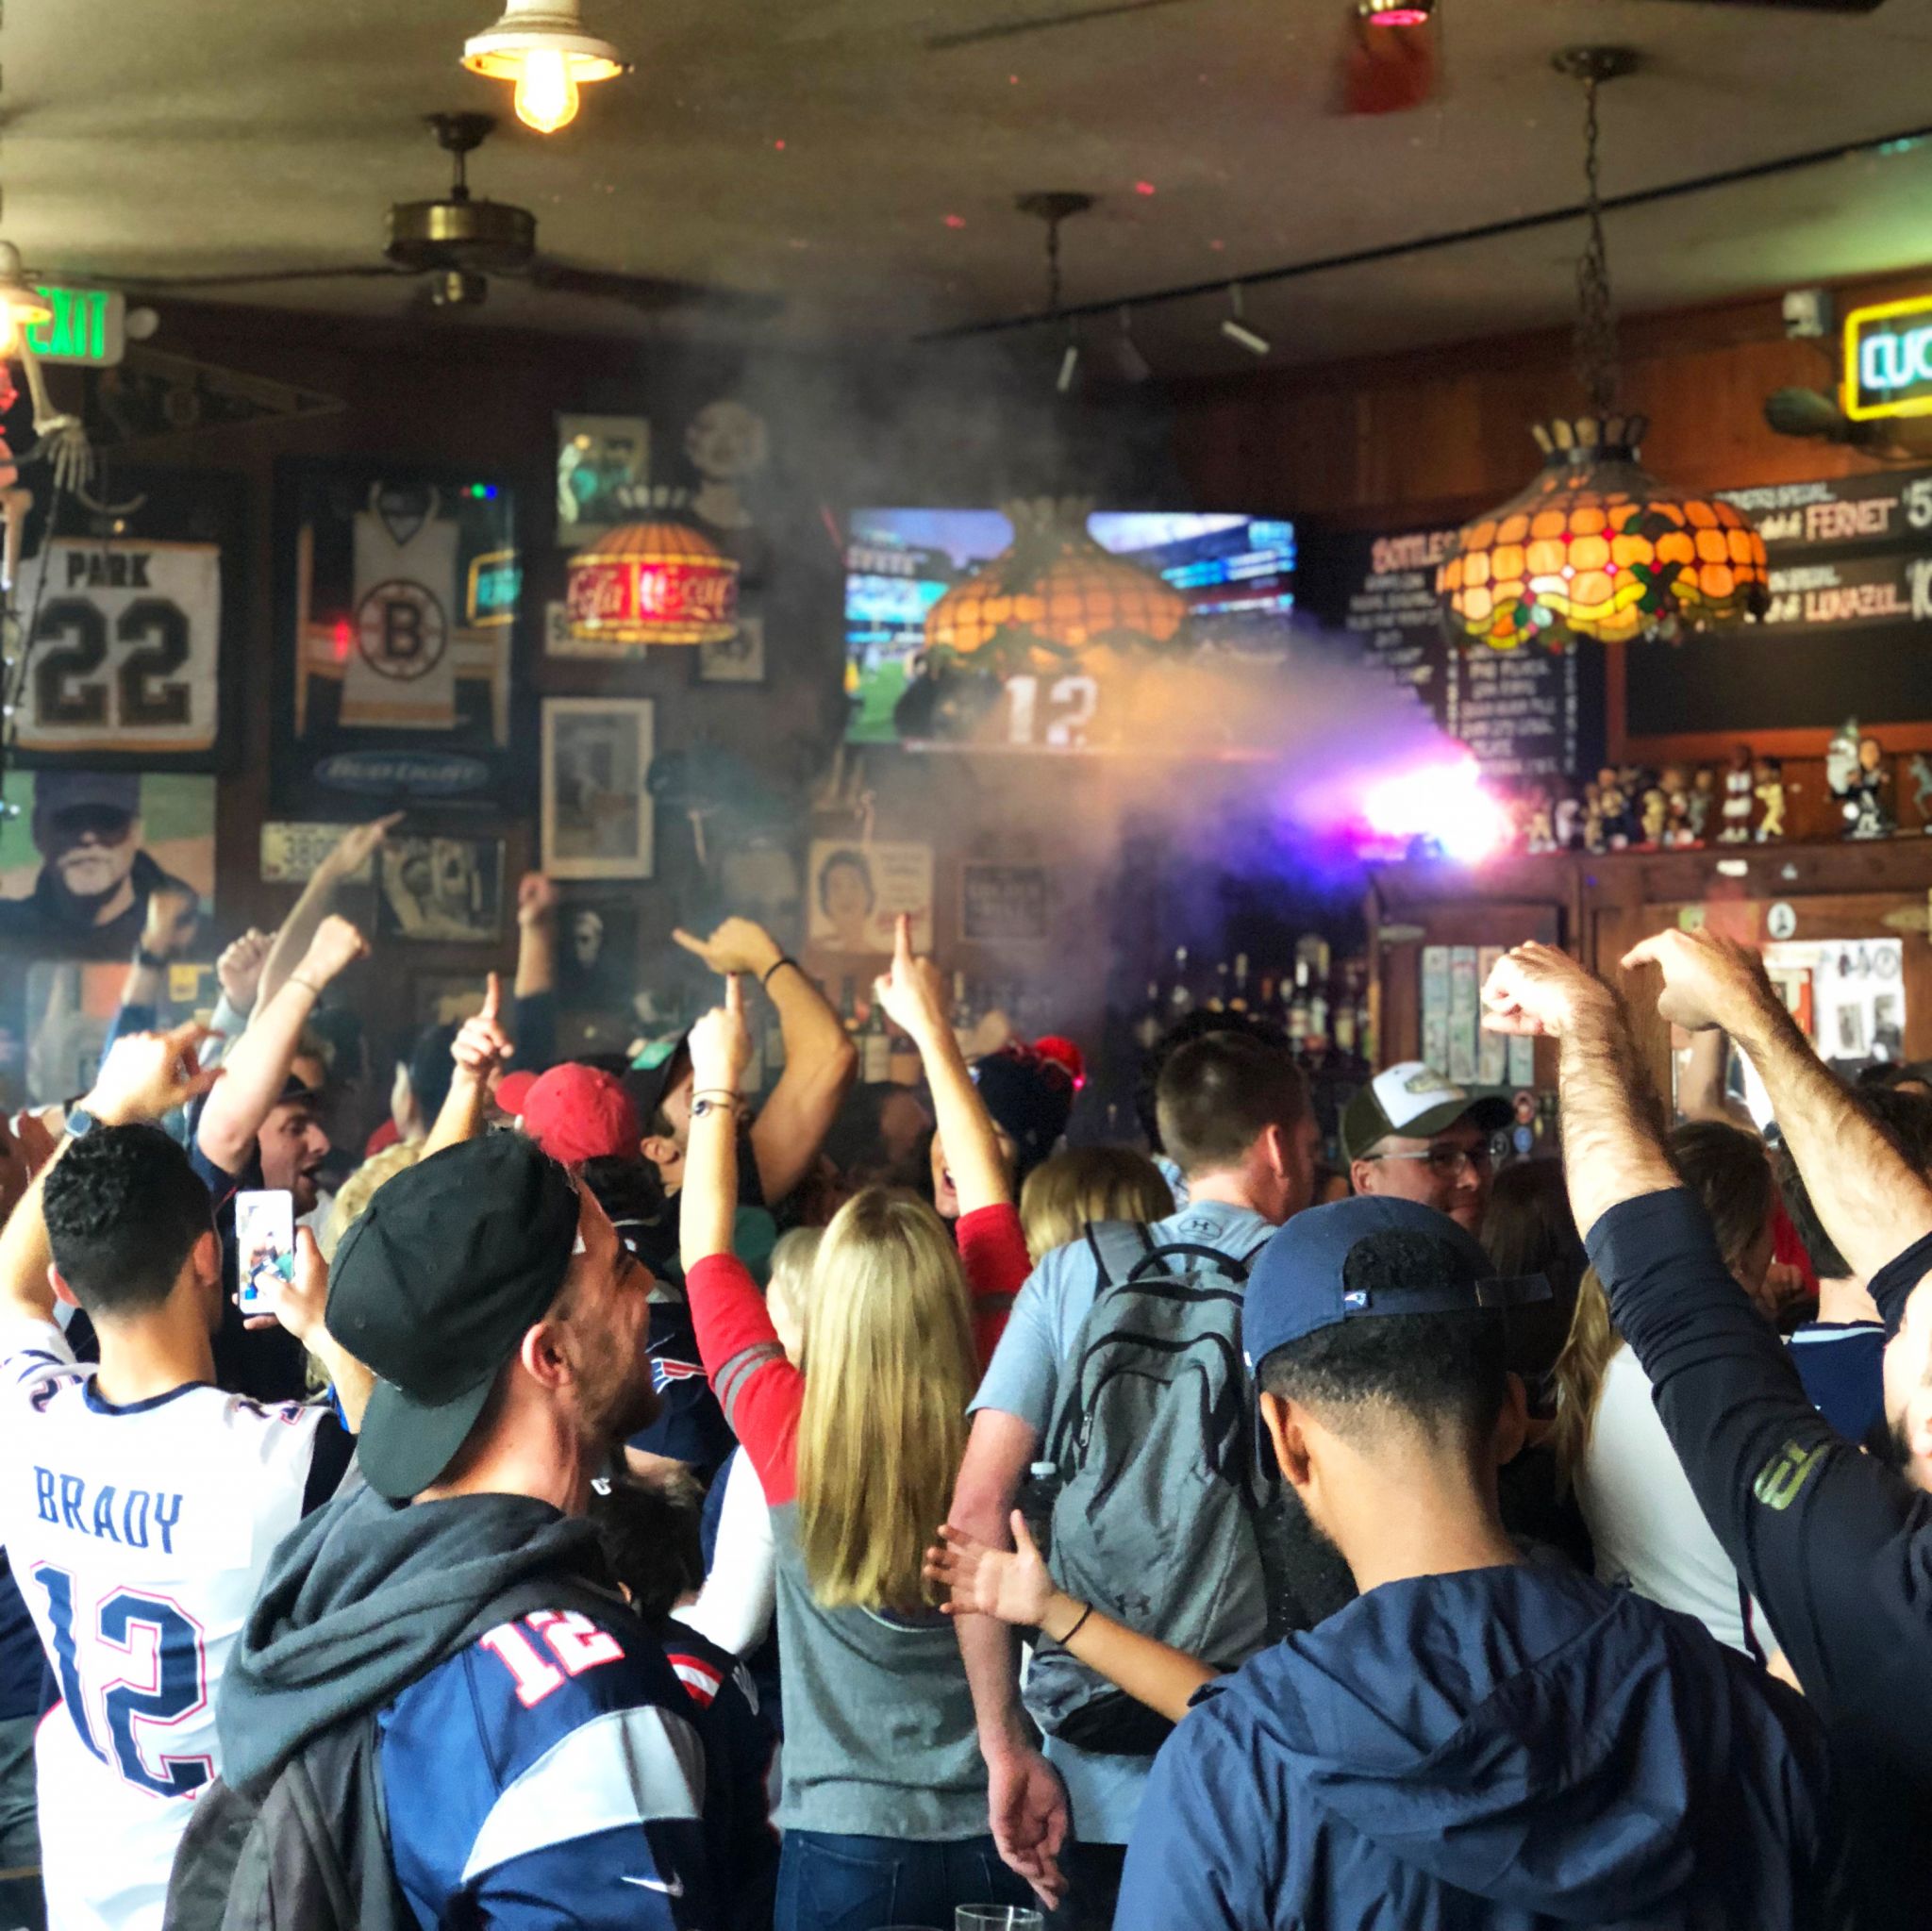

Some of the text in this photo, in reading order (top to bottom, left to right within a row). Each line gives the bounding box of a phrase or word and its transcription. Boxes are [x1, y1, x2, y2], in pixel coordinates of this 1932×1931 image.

[1805, 497, 1899, 541] FERNET
[66, 551, 152, 588] PARK
[35, 596, 193, 728] 22
[385, 600, 421, 659] B
[1004, 674, 1099, 747] 12
[33, 1465, 183, 1555] BRADY
[28, 1560, 215, 1800] 12
[478, 1607, 626, 1711] 12
